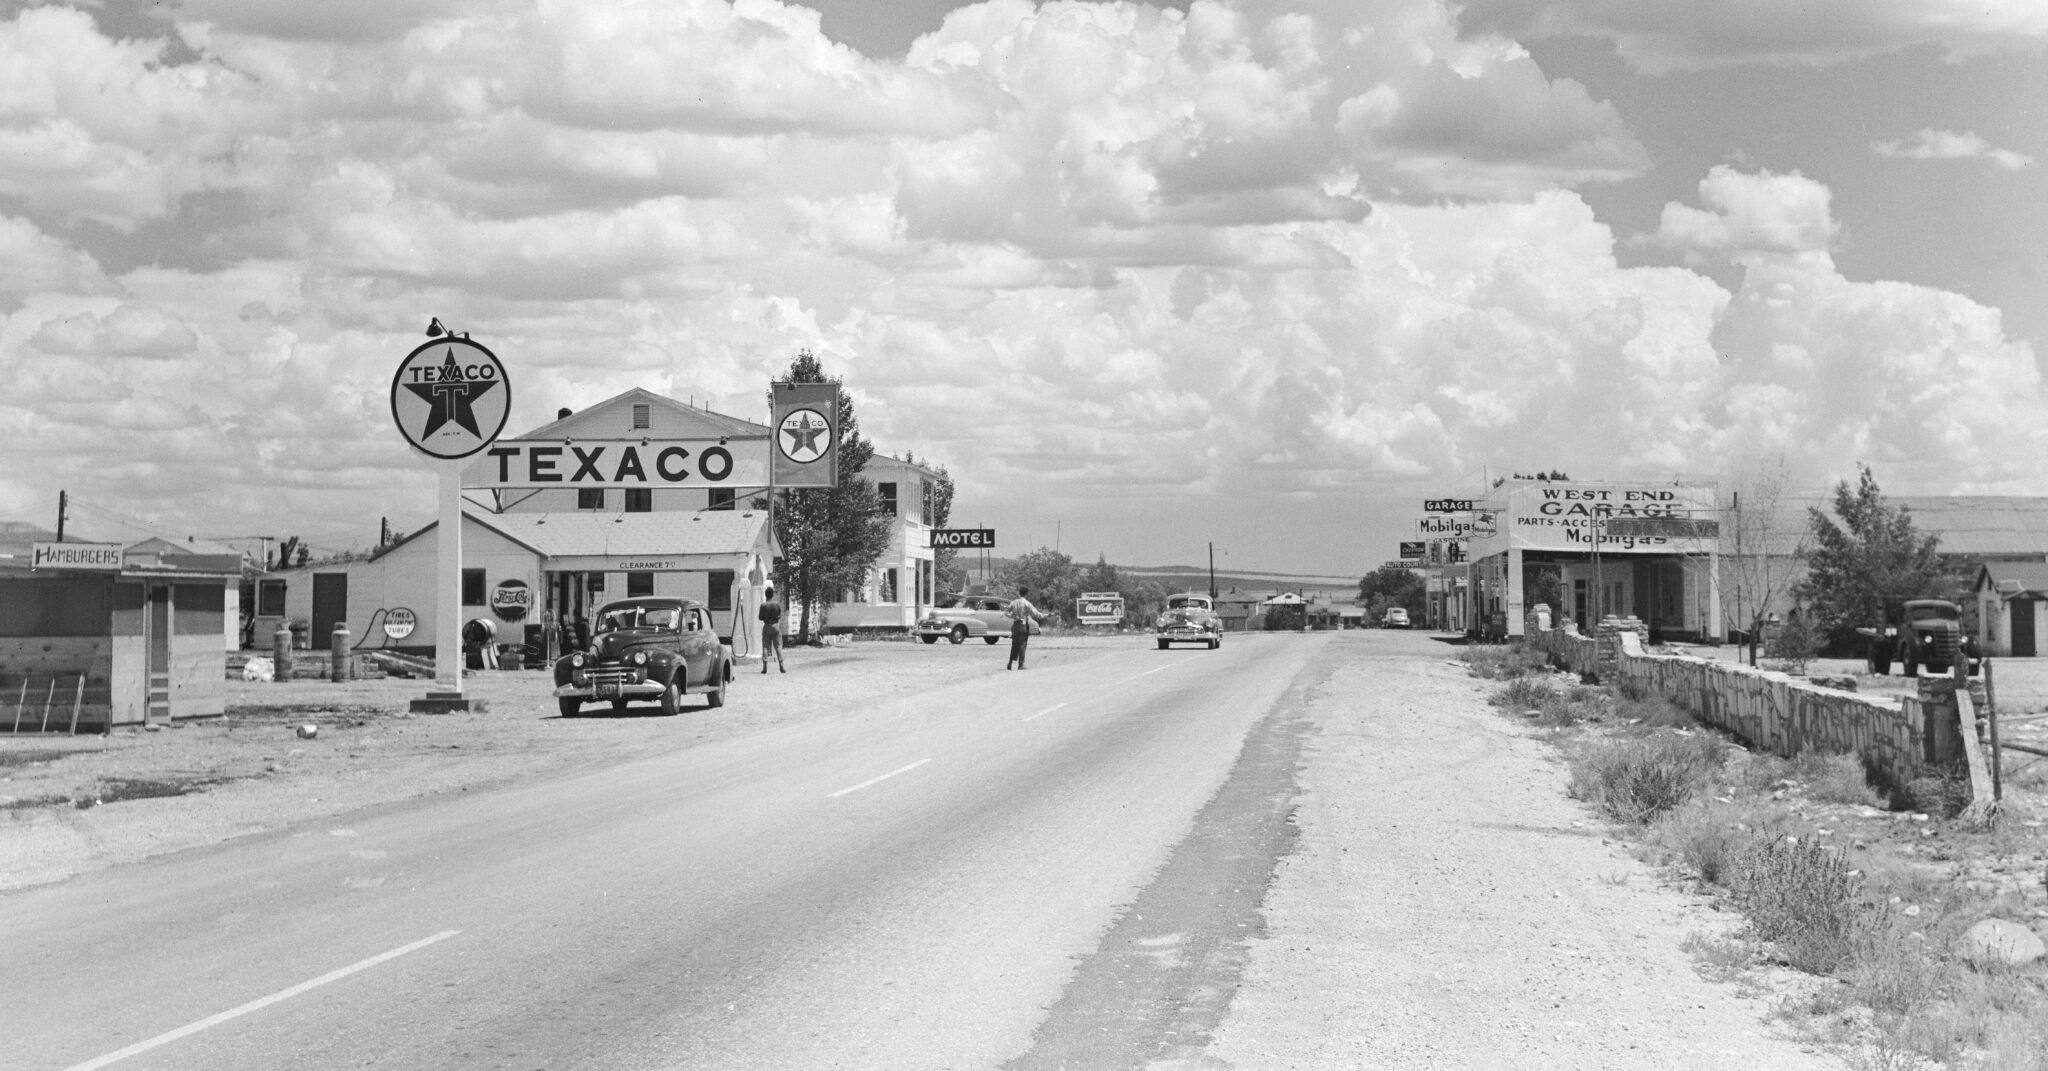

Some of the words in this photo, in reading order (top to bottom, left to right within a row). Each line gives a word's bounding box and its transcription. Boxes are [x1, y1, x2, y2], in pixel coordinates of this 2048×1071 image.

[409, 364, 495, 382] TEXACO
[487, 446, 734, 482] TEXACO
[1542, 489, 1612, 500] WEST
[1625, 490, 1675, 501] END
[1427, 501, 1471, 510] GARAGE
[1540, 501, 1684, 519] GARAGE
[933, 532, 992, 545] MOTEL
[35, 546, 119, 565] HAMBURGERS
[619, 561, 663, 569] CLEARANCE
